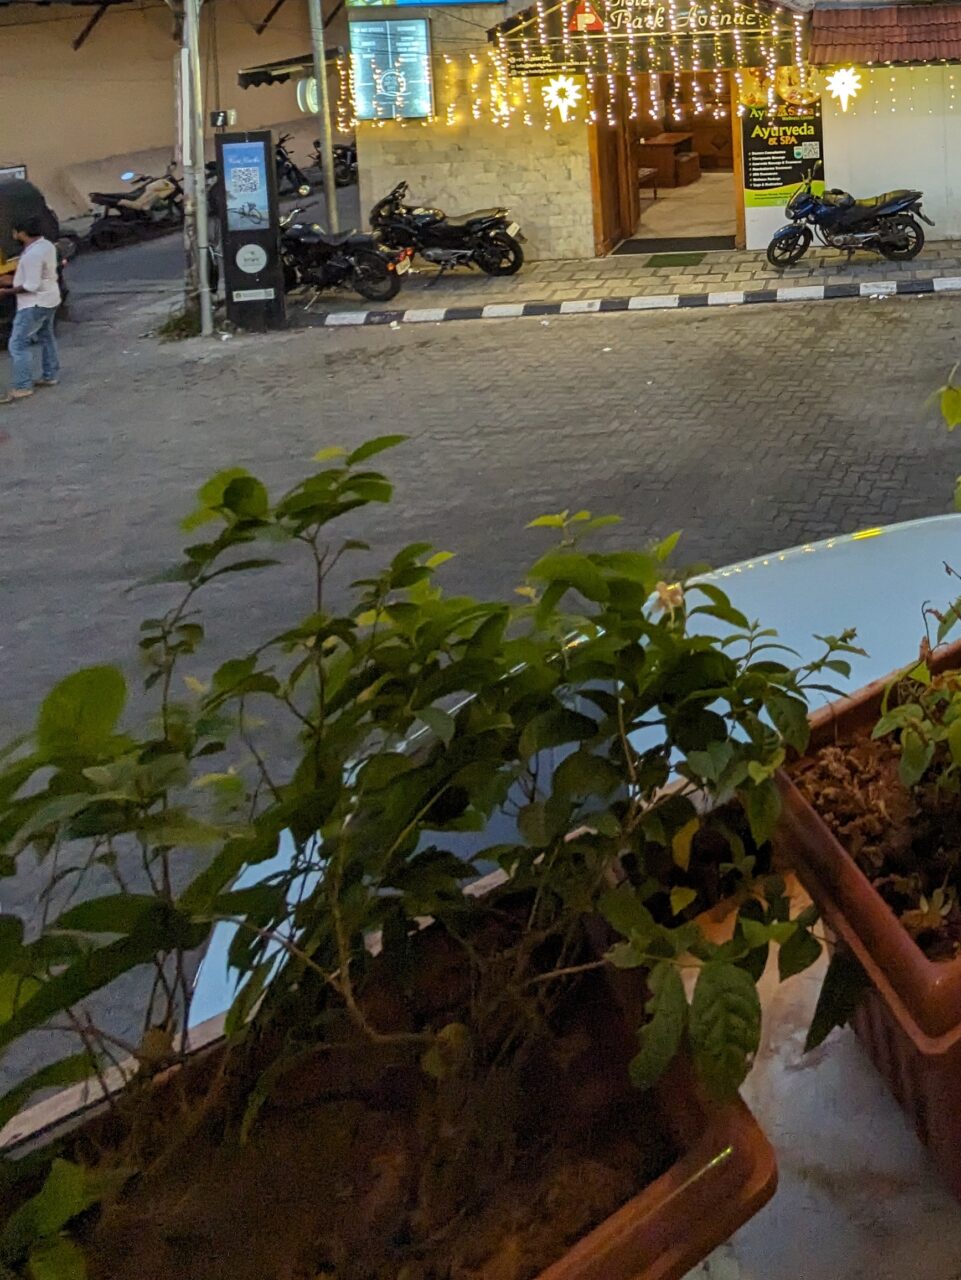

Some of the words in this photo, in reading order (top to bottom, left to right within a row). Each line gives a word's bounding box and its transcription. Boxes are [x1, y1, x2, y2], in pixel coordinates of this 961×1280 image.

[608, 7, 665, 30] Park
[751, 123, 815, 139] Ayurveda
[780, 135, 798, 145] SPA
